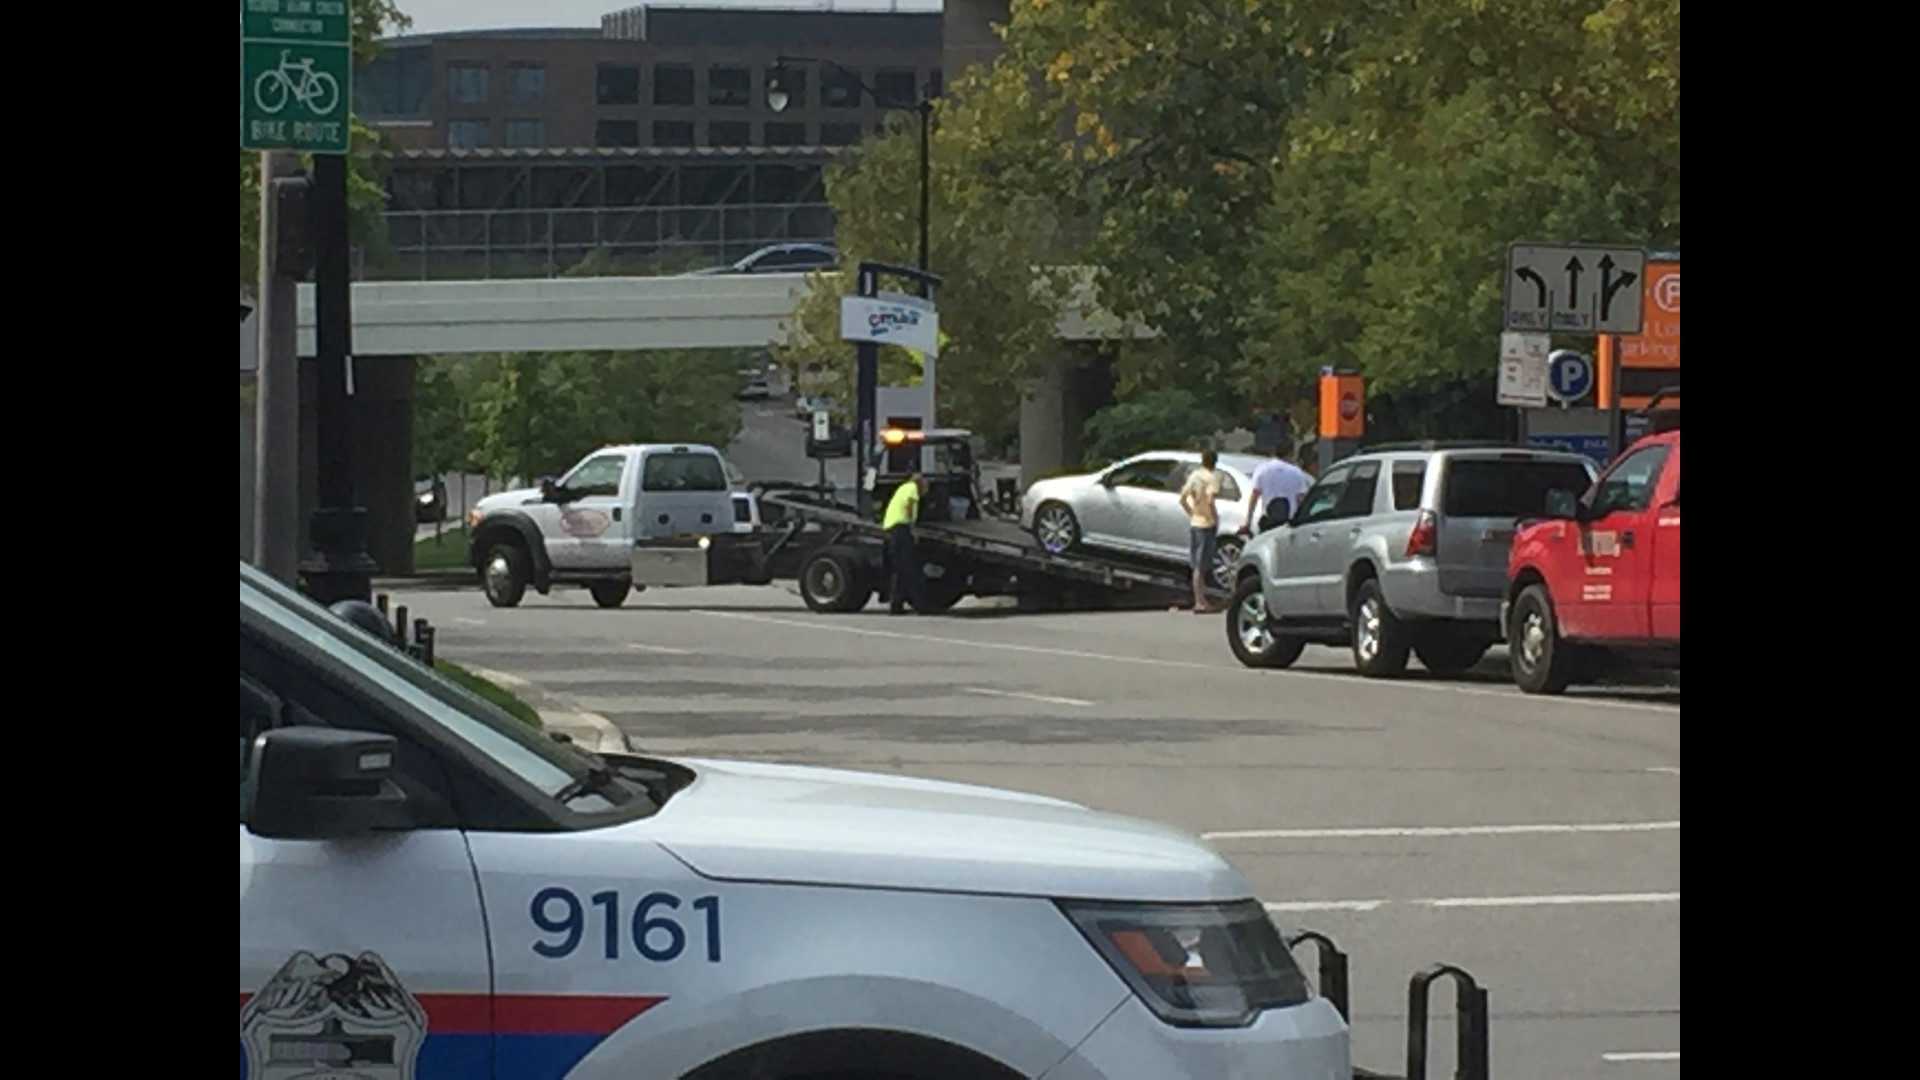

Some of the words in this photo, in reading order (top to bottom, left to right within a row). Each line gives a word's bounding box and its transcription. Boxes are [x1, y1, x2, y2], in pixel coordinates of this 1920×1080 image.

[251, 120, 287, 141] BIKE
[294, 121, 341, 143] ROUTE
[1621, 340, 1678, 361] arking
[1561, 360, 1584, 392] P
[530, 887, 721, 963] 9161
